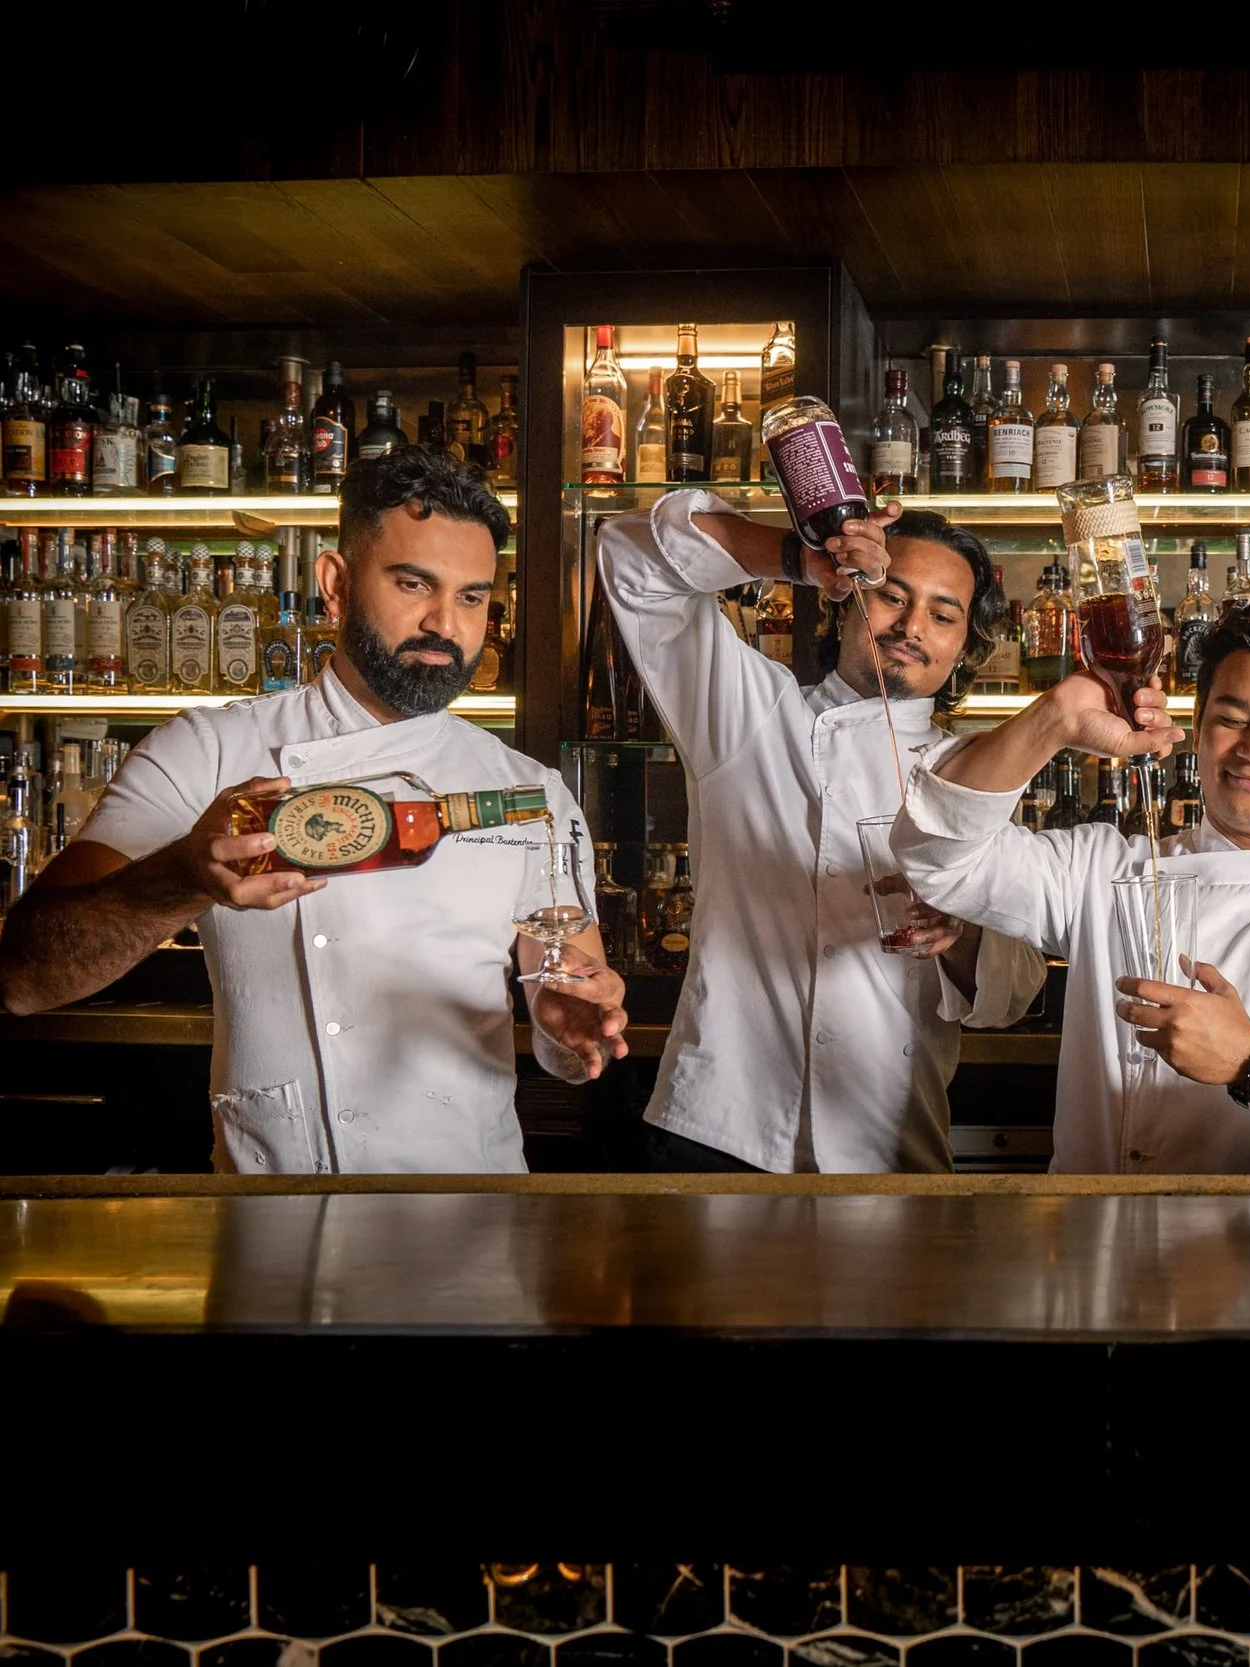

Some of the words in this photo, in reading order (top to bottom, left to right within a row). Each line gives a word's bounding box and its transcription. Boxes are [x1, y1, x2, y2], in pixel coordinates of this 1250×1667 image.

[992, 428, 1030, 437] BENRIACH
[284, 797, 316, 848] STRAIGHT
[301, 847, 325, 860] RYE
[333, 794, 376, 857] MICHTER'S
[452, 832, 495, 845] Principal
[495, 835, 534, 846] Bartender
